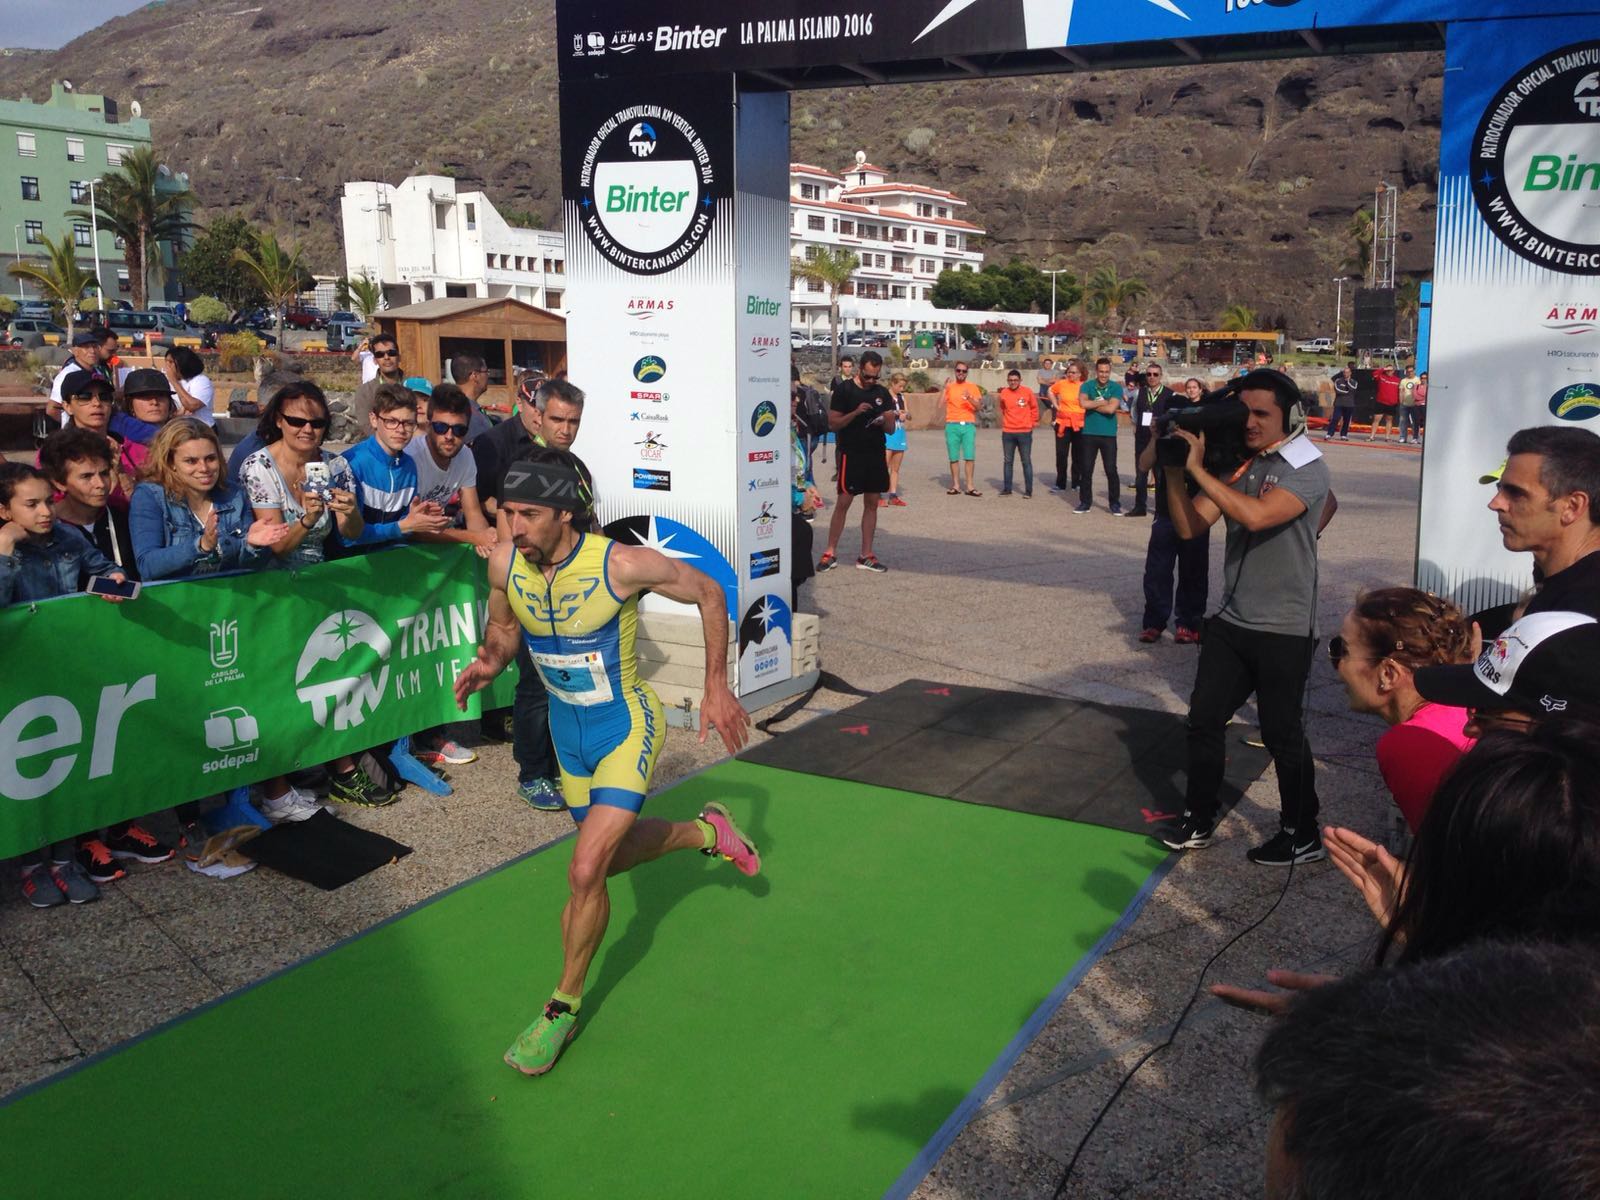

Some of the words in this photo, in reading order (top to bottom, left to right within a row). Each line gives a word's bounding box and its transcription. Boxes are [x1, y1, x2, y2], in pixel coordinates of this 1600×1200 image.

[741, 22, 753, 44] LA
[758, 19, 795, 43] PALMA
[800, 16, 840, 40] ISLAND
[844, 13, 873, 37] 2016
[611, 31, 653, 44] ARMAS
[654, 25, 727, 51] Binter
[1480, 91, 1523, 158] PATROCINADOR
[1517, 64, 1555, 96] OFICIAL
[580, 136, 602, 187] PATROCINADOR
[597, 117, 618, 140] OFICIAL
[615, 105, 661, 123] TRANSVULCANIA
[662, 108, 673, 122] KM
[671, 113, 697, 143] VERTICAL
[691, 138, 710, 165] BINTER
[701, 165, 714, 184] 2016
[606, 185, 690, 213] Binter
[587, 213, 709, 270] WWW.BINTERCANARIAS.COM
[627, 299, 674, 310] ARMAS
[746, 295, 781, 316] Binter
[752, 337, 780, 347] ARMAS
[637, 392, 661, 400] SPAR
[641, 449, 661, 458] CICAR
[753, 452, 773, 460] SPAR
[211, 668, 239, 679] CABILDO
[224, 672, 245, 682] PALMA
[557, 669, 571, 682] 3
[396, 668, 421, 700] KM
[202, 747, 259, 774] sodepal
